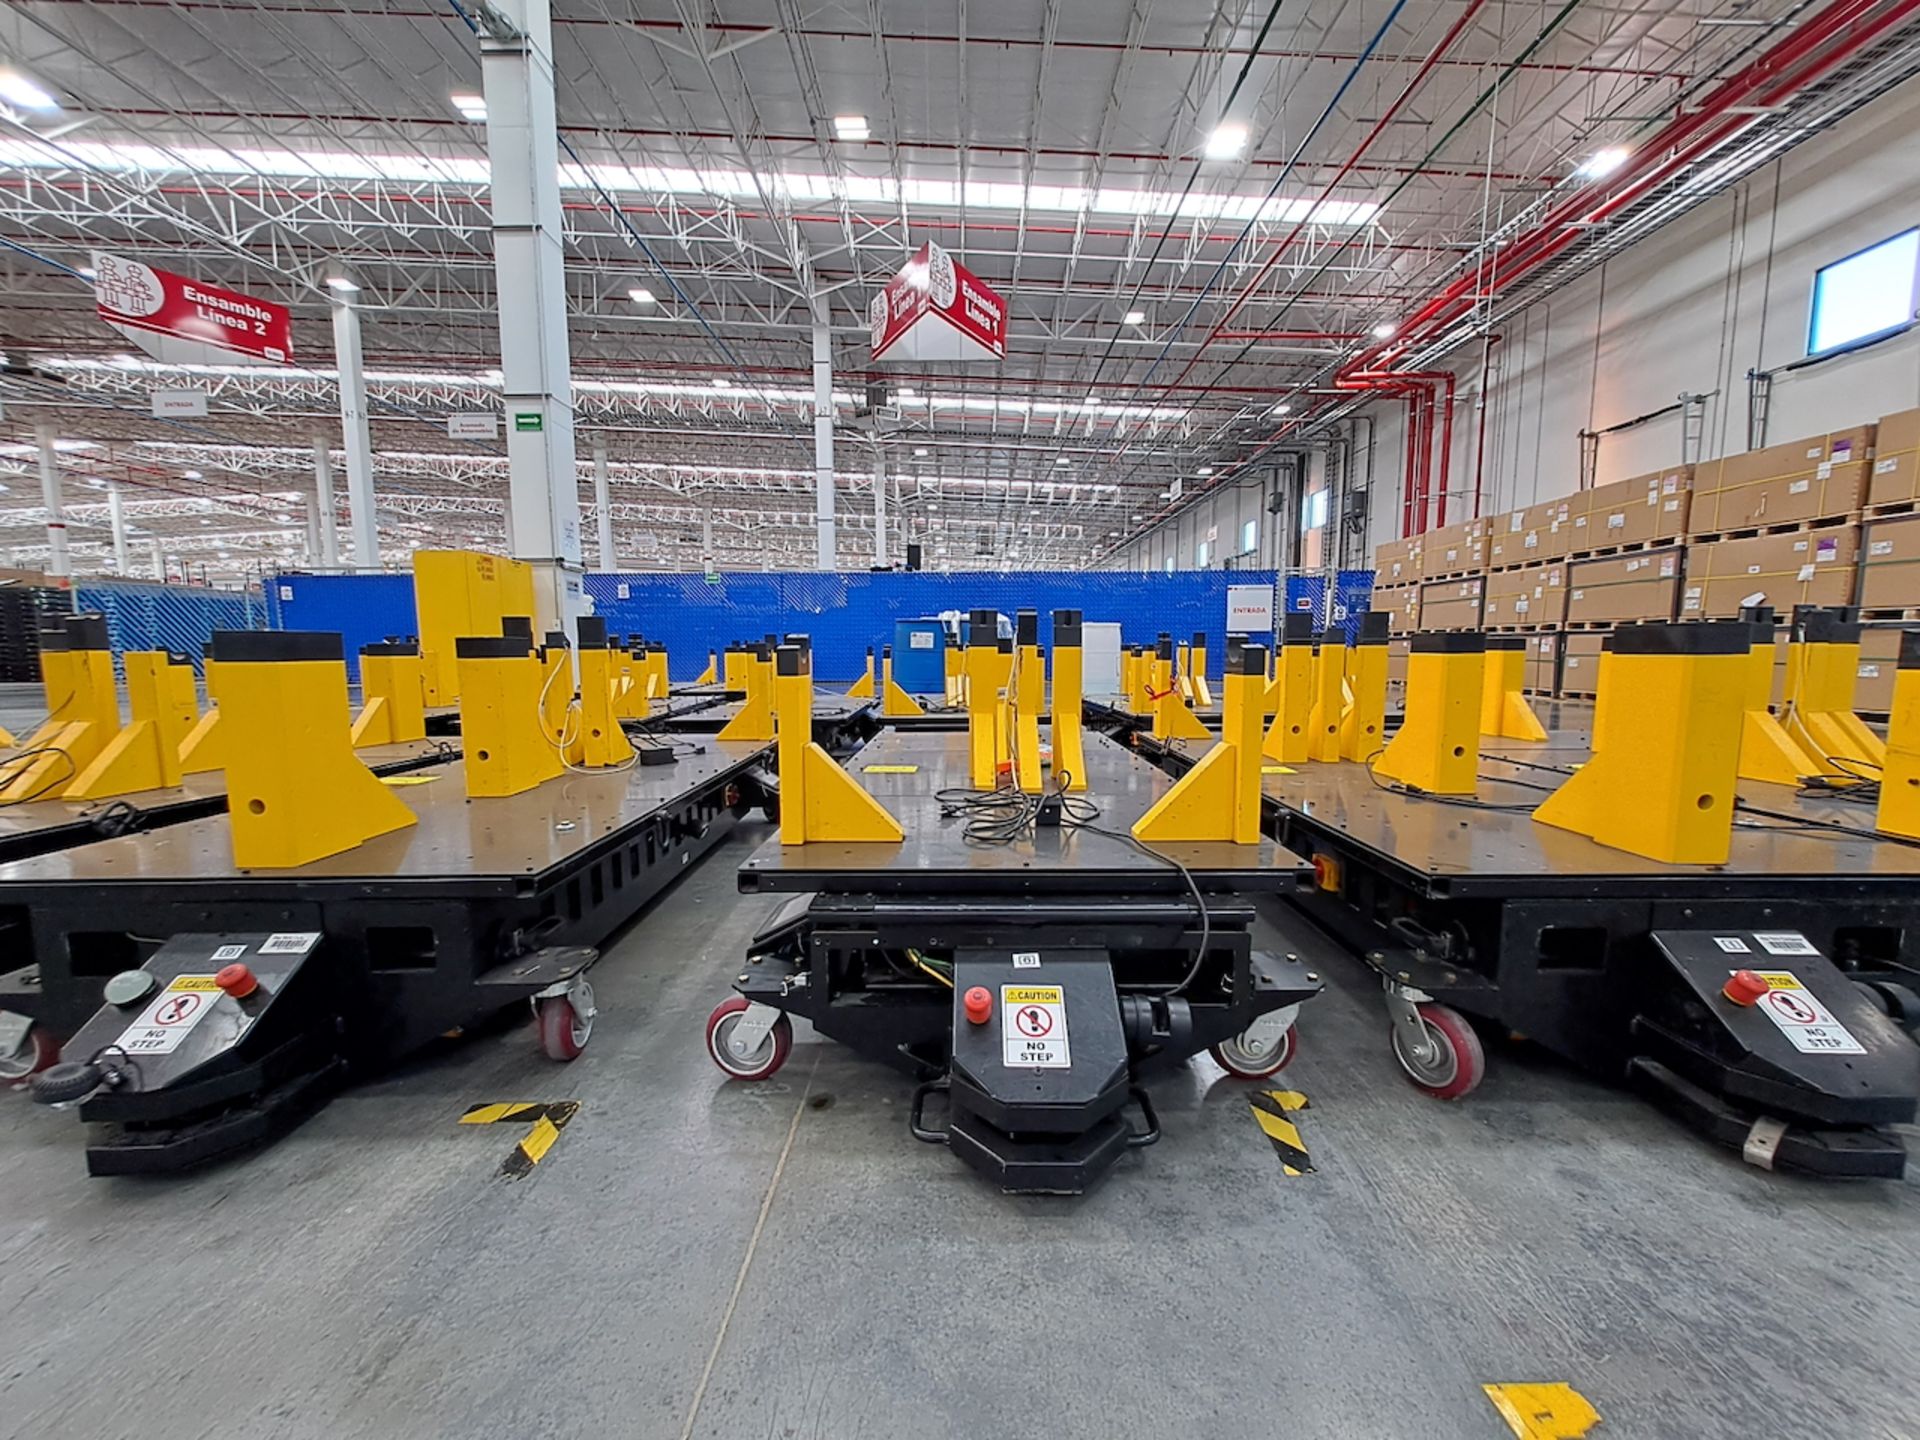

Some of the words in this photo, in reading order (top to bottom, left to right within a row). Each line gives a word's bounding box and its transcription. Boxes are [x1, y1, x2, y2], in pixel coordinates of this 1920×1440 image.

[183, 285, 272, 322] Ensamble
[962, 279, 1001, 322] Ensamble
[254, 320, 266, 336] 2
[993, 319, 999, 336] 1
[1018, 991, 1057, 1000] CAUTION
[145, 1029, 166, 1039] NO
[1805, 1028, 1827, 1037] NO
[128, 1040, 166, 1050] STEP
[1027, 1042, 1046, 1051] NO
[1807, 1037, 1843, 1048] STEP
[1020, 1052, 1054, 1062] STEP
